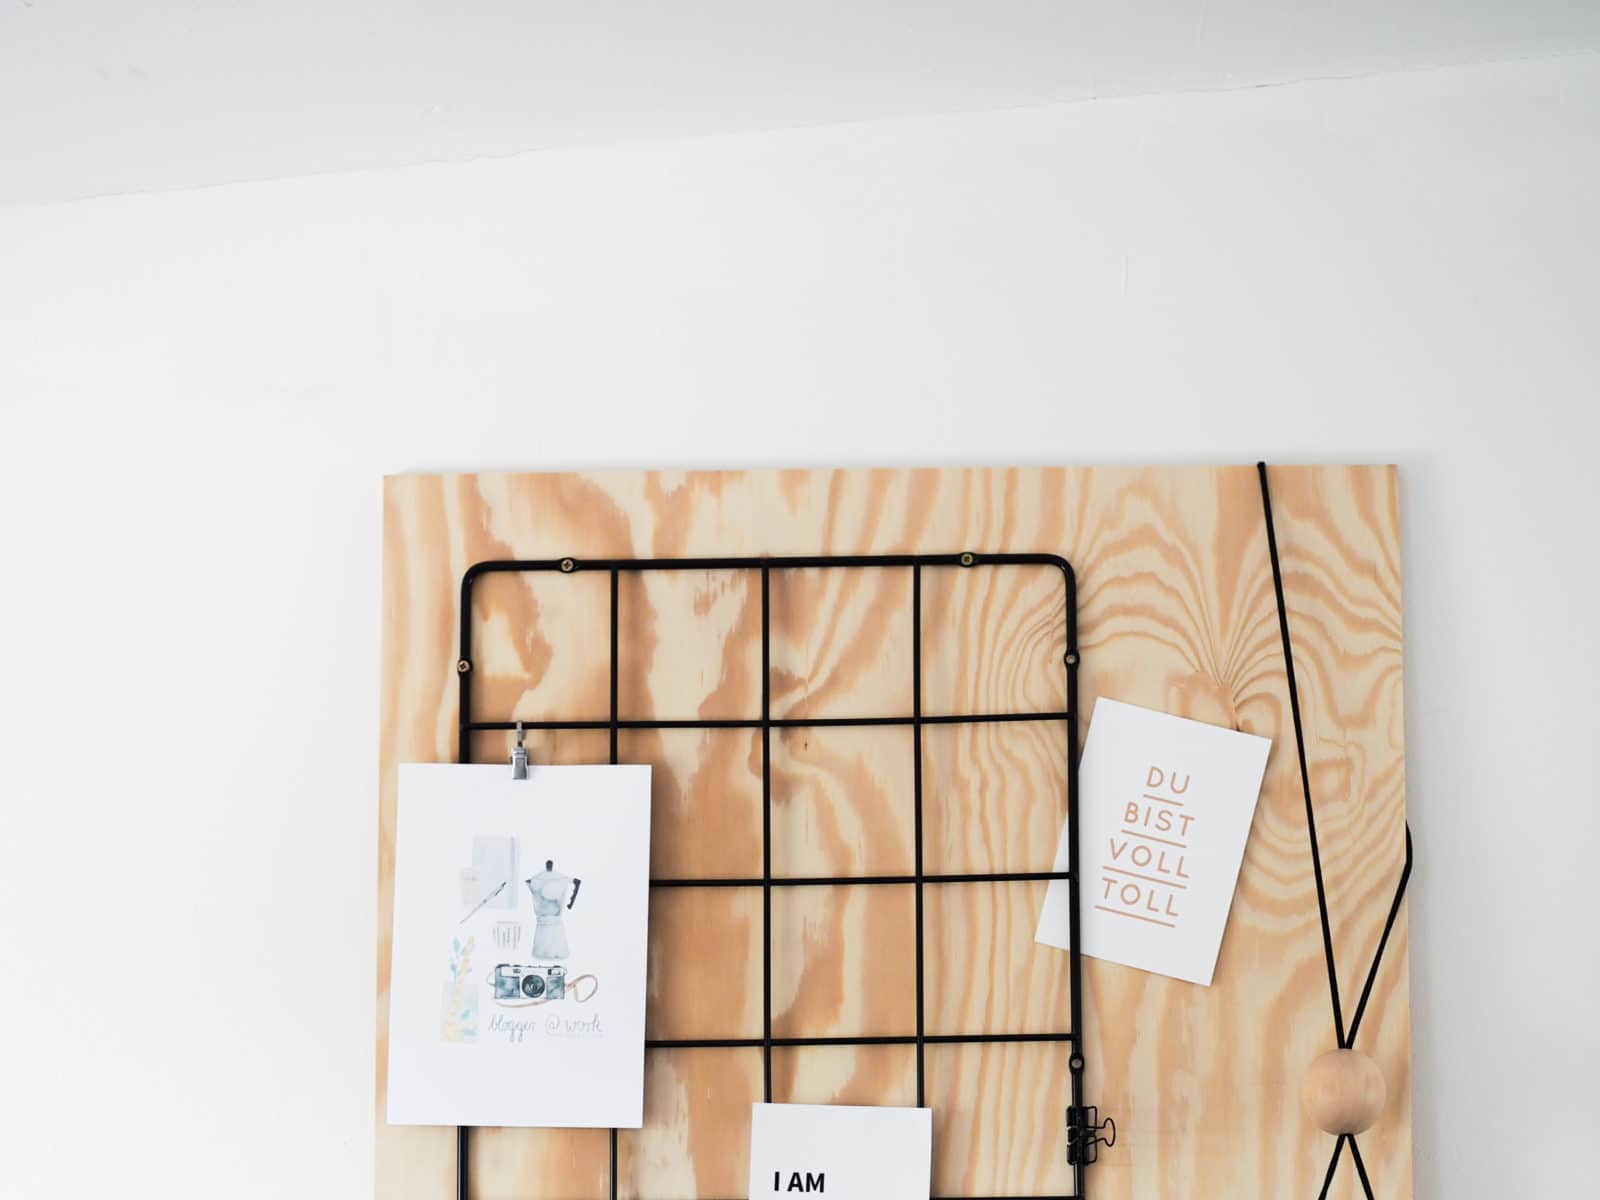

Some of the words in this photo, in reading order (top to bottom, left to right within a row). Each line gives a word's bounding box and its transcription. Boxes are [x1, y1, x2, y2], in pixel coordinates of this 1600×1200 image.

[1146, 766, 1190, 794] DU
[1123, 801, 1195, 836] BIST
[1109, 838, 1190, 879] VOLL
[1101, 877, 1179, 917] TOLL
[488, 1014, 537, 1042] blogger
[545, 1013, 561, 1037] @
[562, 1012, 605, 1033] work
[773, 1171, 780, 1192] I
[787, 1172, 825, 1193] AM
